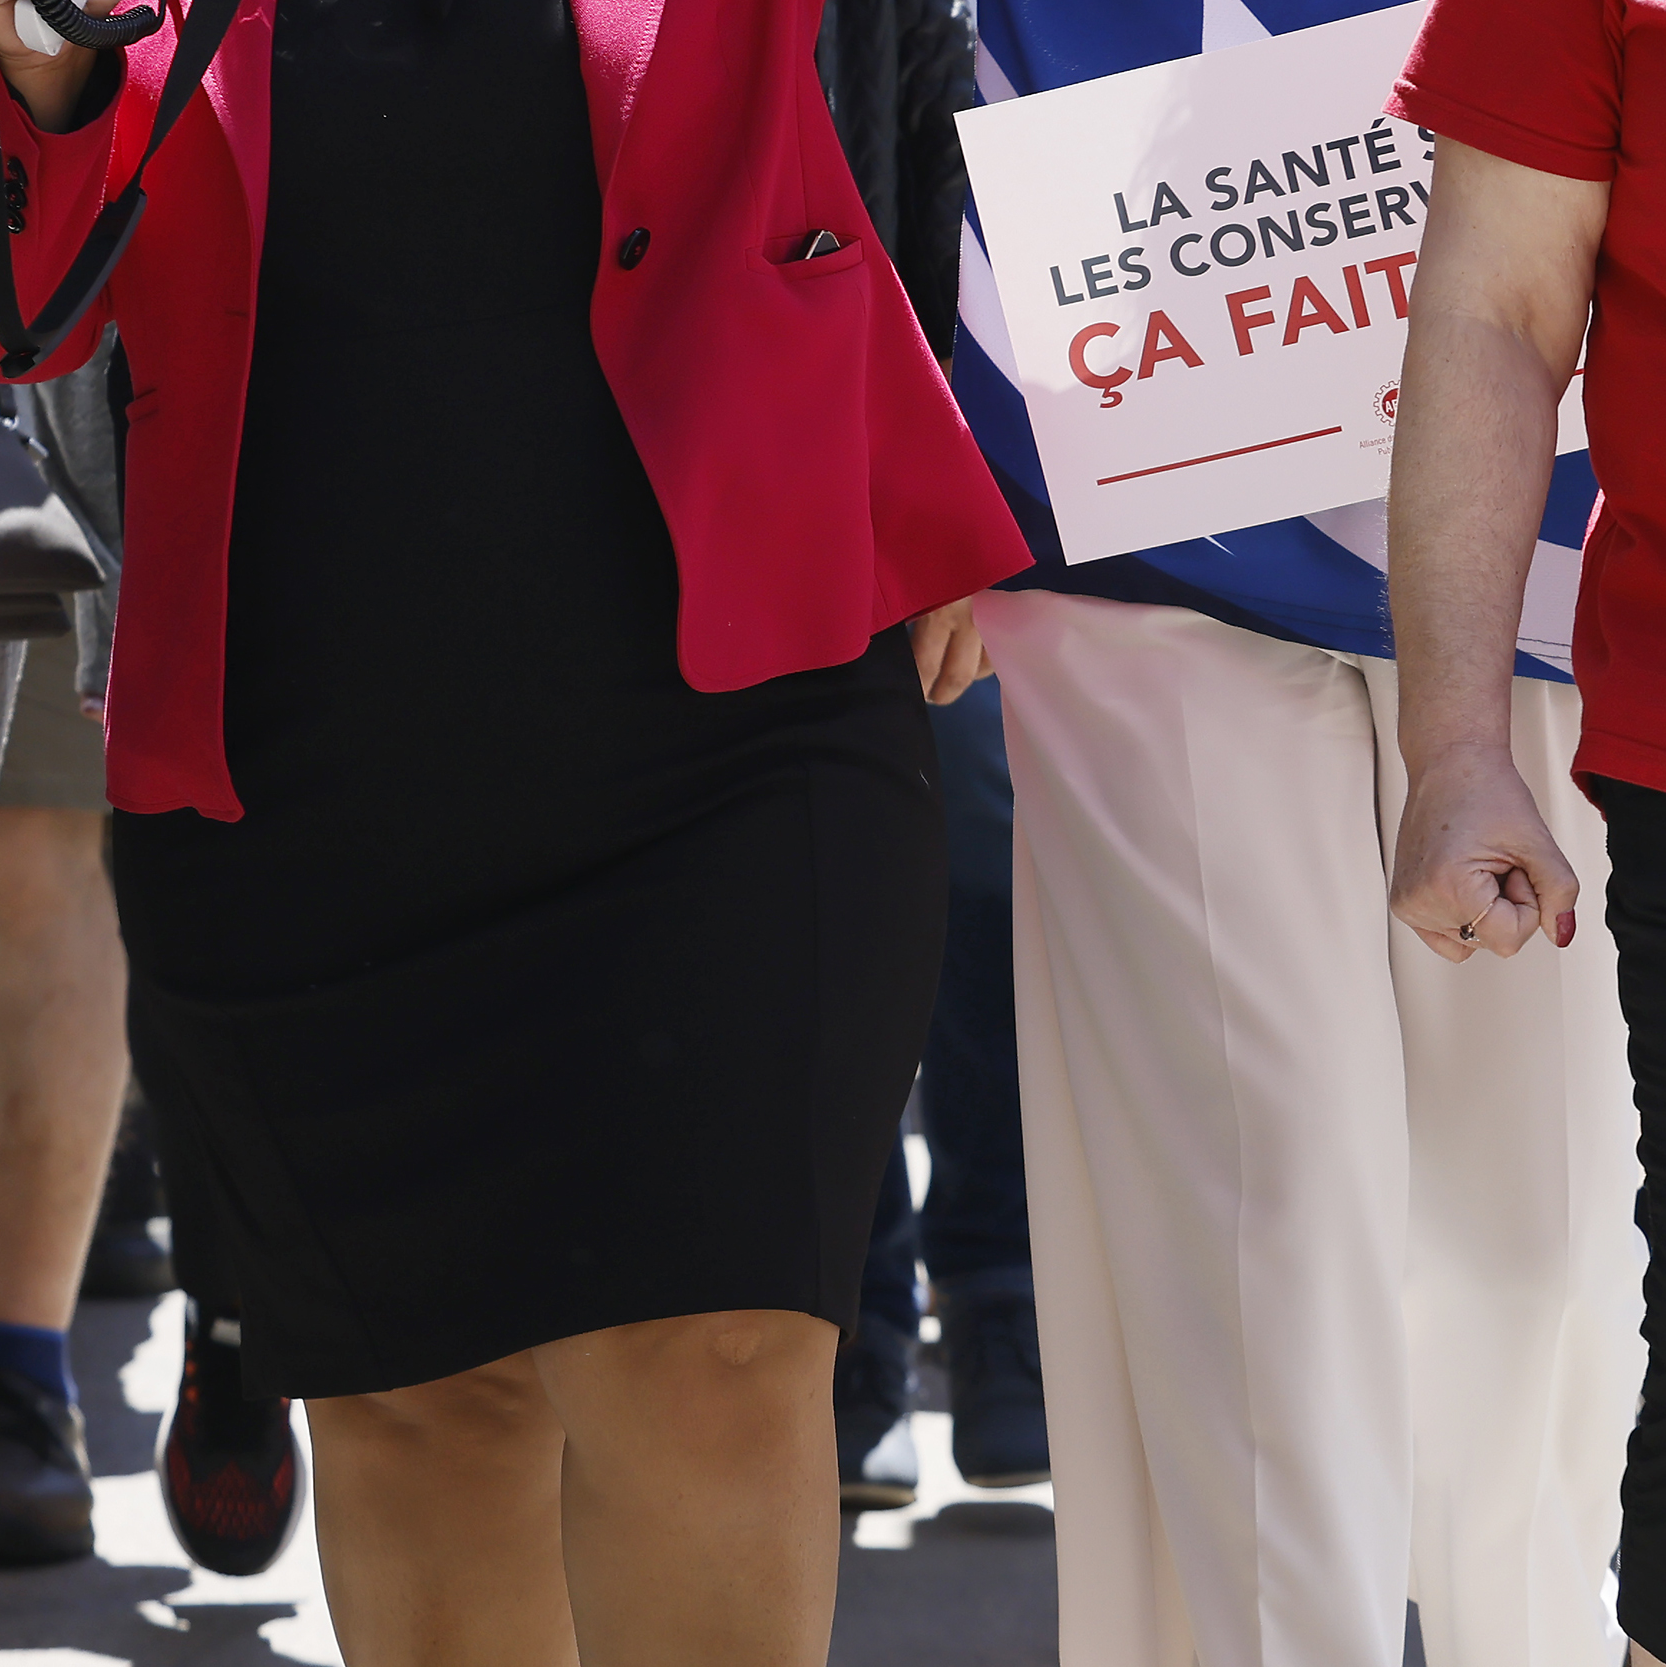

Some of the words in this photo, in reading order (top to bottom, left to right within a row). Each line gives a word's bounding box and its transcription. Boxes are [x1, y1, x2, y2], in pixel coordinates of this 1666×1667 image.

[1113, 180, 1192, 234] LA
[1205, 117, 1402, 212] SANTÉ
[1049, 246, 1152, 307] LES
[1067, 309, 1205, 410] ÇA
[1225, 250, 1418, 357] FAIT
[1359, 437, 1386, 449] Alliance
